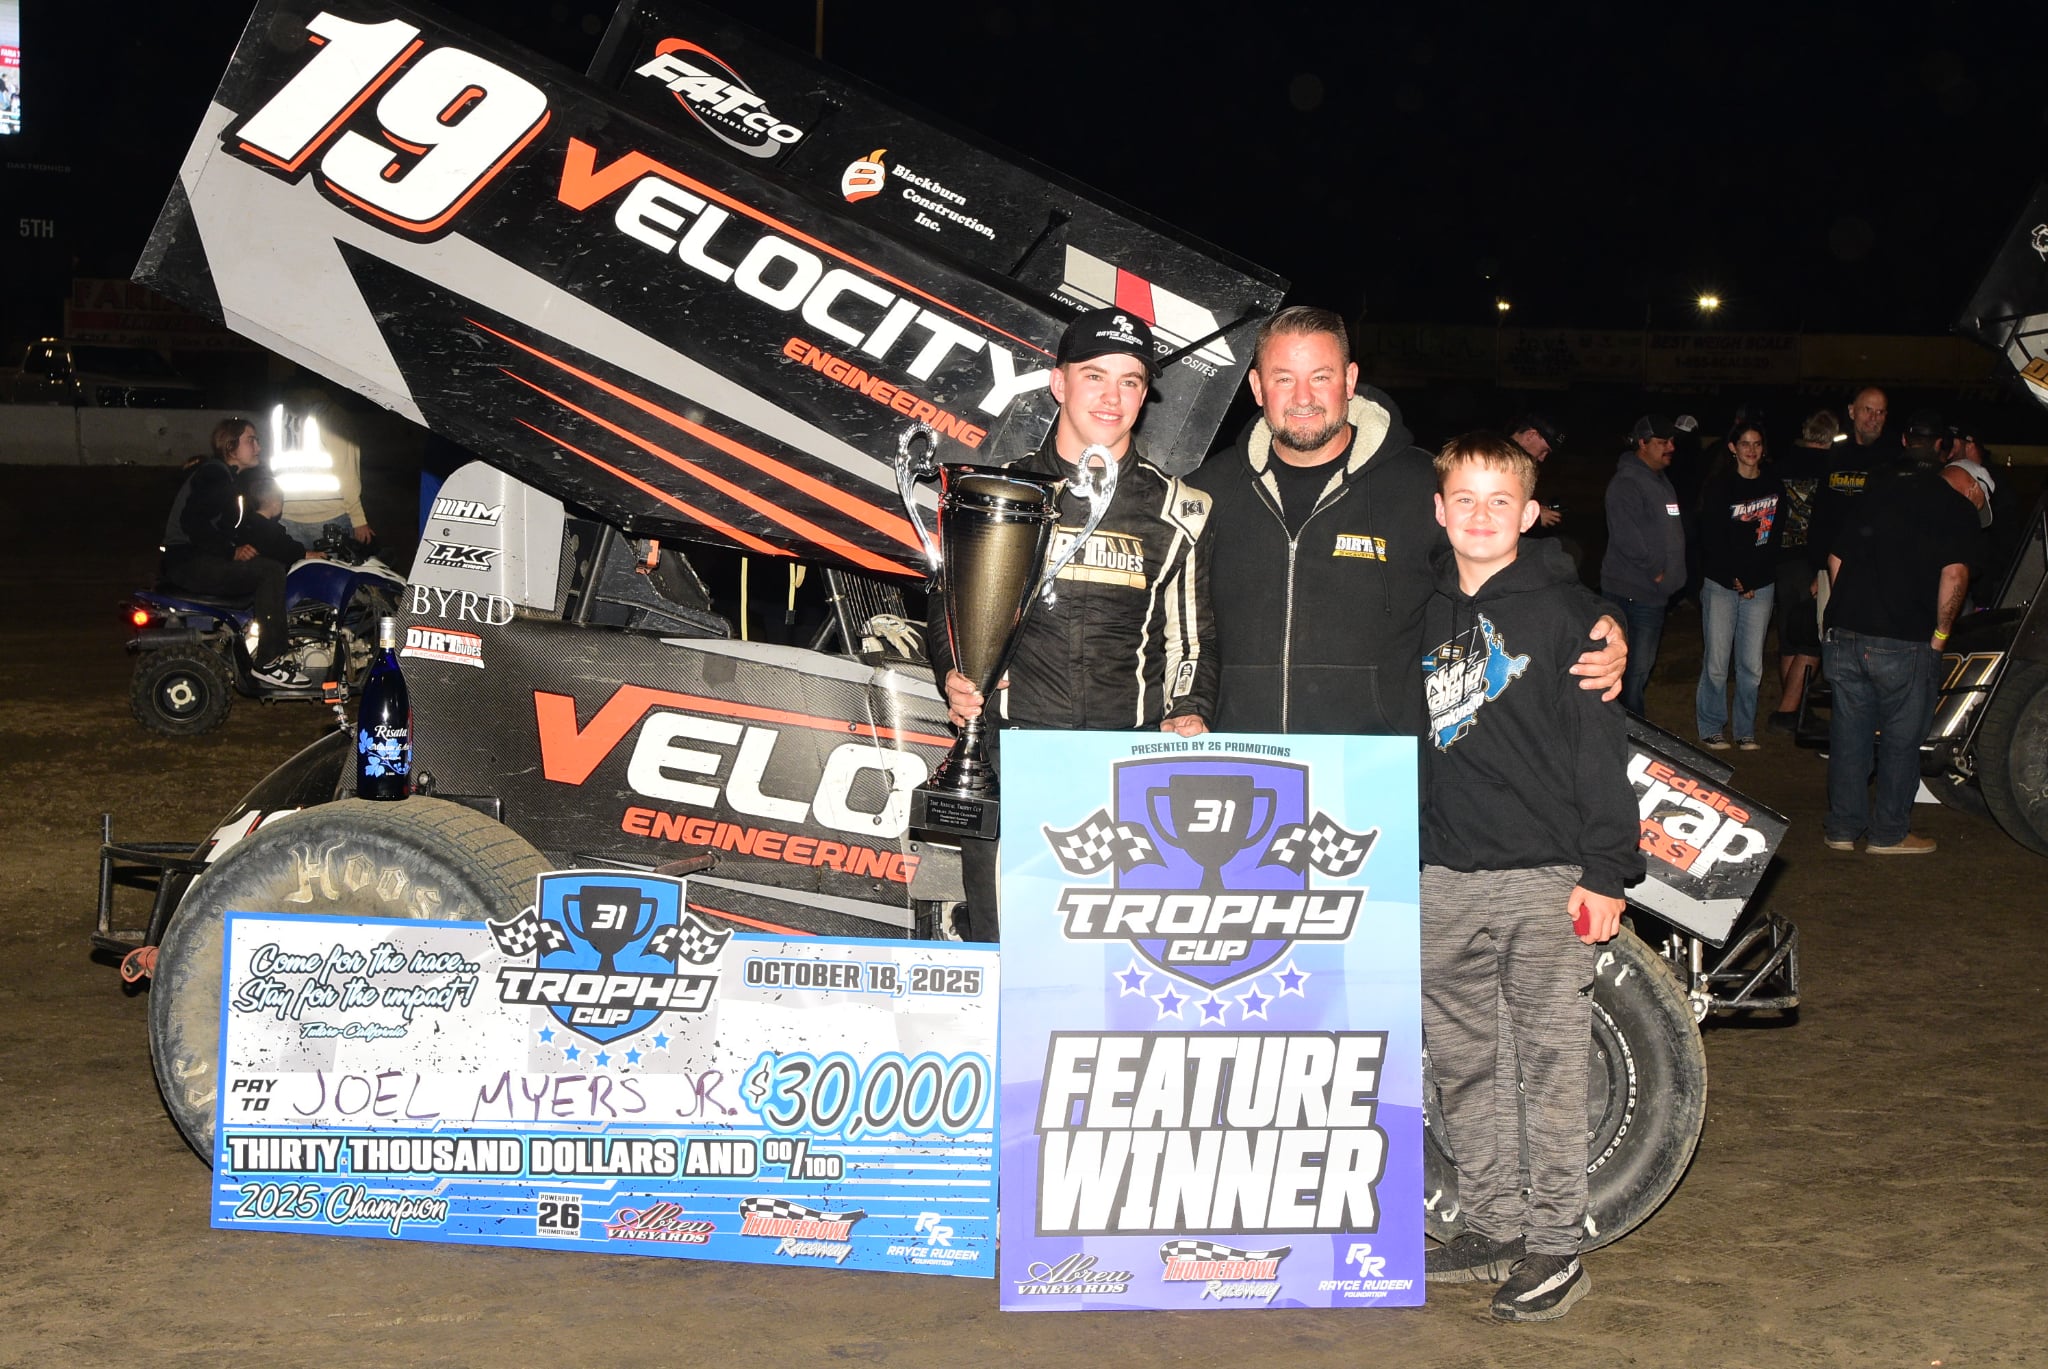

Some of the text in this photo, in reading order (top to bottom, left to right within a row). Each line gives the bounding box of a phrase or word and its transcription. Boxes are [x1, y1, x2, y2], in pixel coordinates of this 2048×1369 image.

[237, 12, 550, 230] 19
[694, 104, 760, 138] PERFORMANCE
[891, 163, 967, 206] Blackburn
[19, 218, 55, 239] 5TH
[902, 188, 997, 241] Construction,
[914, 212, 942, 232] Inc.
[557, 136, 1051, 418] VELOCITY
[1096, 330, 1144, 346] RAYCE RUDEEN
[783, 337, 988, 449] ENGINEERING
[1335, 537, 1373, 552] DIRT
[1098, 550, 1144, 573] DUDES
[411, 583, 514, 625] BYRD
[406, 629, 457, 653] DIRT
[374, 725, 408, 740] Risata
[1131, 741, 1291, 757] PRESENTED BY 26 PROMOTIONS
[1645, 760, 1751, 824] Eddie
[1187, 799, 1236, 833] 31
[621, 806, 922, 885] ENGINEERING
[590, 904, 627, 930] 31
[1064, 894, 1358, 935] TROPHY
[250, 942, 481, 985] Come for the race...
[1167, 940, 1246, 962] CUP
[501, 971, 713, 1008] TROPHY
[747, 961, 981, 994] OCTOBER 18, 2025
[232, 977, 294, 1020] Stay
[289, 977, 340, 1020] for
[339, 976, 380, 1012] the
[571, 1007, 631, 1024] CUP
[232, 1079, 278, 1093] PAY
[293, 1069, 738, 1122] JOEL MYERS JR.
[1040, 1036, 1382, 1128] FEATURE
[241, 1097, 271, 1111] TO
[748, 1060, 982, 1135] $30,000
[229, 1137, 341, 1171] THIRTY
[348, 1138, 521, 1173] THOUSAND
[530, 1139, 677, 1174] DOLLARS
[685, 1141, 756, 1175] AND
[1587, 1113, 1632, 1174] FORGED
[1042, 1128, 1380, 1232] WINNER
[236, 1183, 449, 1235] 2025 Champion
[540, 1194, 569, 1202] POWERED
[538, 1202, 580, 1228] 26
[604, 1203, 715, 1232] Abreu
[740, 1212, 855, 1241] THUNDERBOWL
[538, 1228, 579, 1236] PROMOTIONS
[607, 1229, 708, 1243] VINEYARDS
[774, 1238, 853, 1265] Raceway
[887, 1246, 980, 1261] RAYCE RUDEEN
[911, 1258, 954, 1266] FOUNDATION
[1013, 1253, 1135, 1284] Abreu
[1163, 1256, 1281, 1280] THUNDERBOWL
[1018, 1284, 1129, 1295] VINEYARDS
[1200, 1279, 1281, 1304] Raceway
[1318, 1279, 1413, 1291] RAYCE RUDEEN
[1343, 1291, 1388, 1299] FOUNDATION
